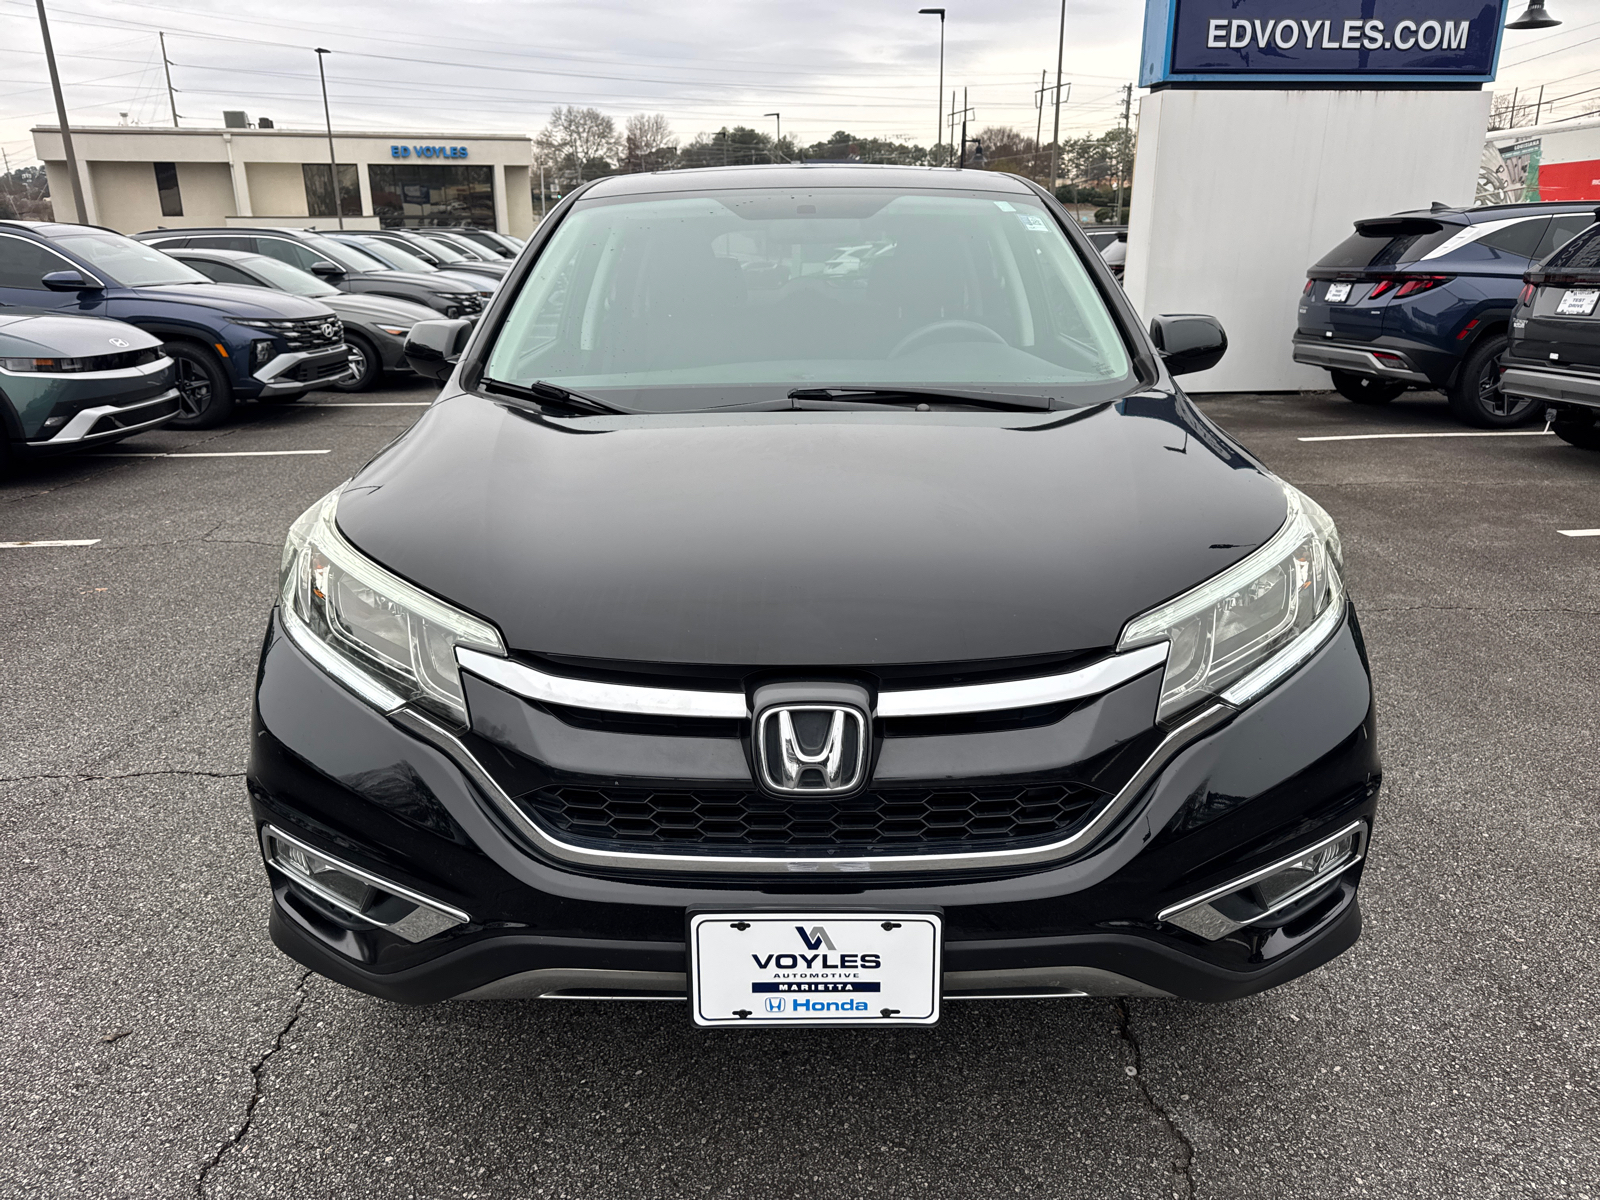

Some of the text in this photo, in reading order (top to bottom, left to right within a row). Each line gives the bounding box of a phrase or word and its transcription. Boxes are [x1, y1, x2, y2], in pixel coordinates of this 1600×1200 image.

[1207, 19, 1469, 50] EDVOYLES.COM
[390, 145, 468, 158] ED VOYLES
[751, 953, 881, 969] VOYLES
[792, 998, 868, 1011] Honda
